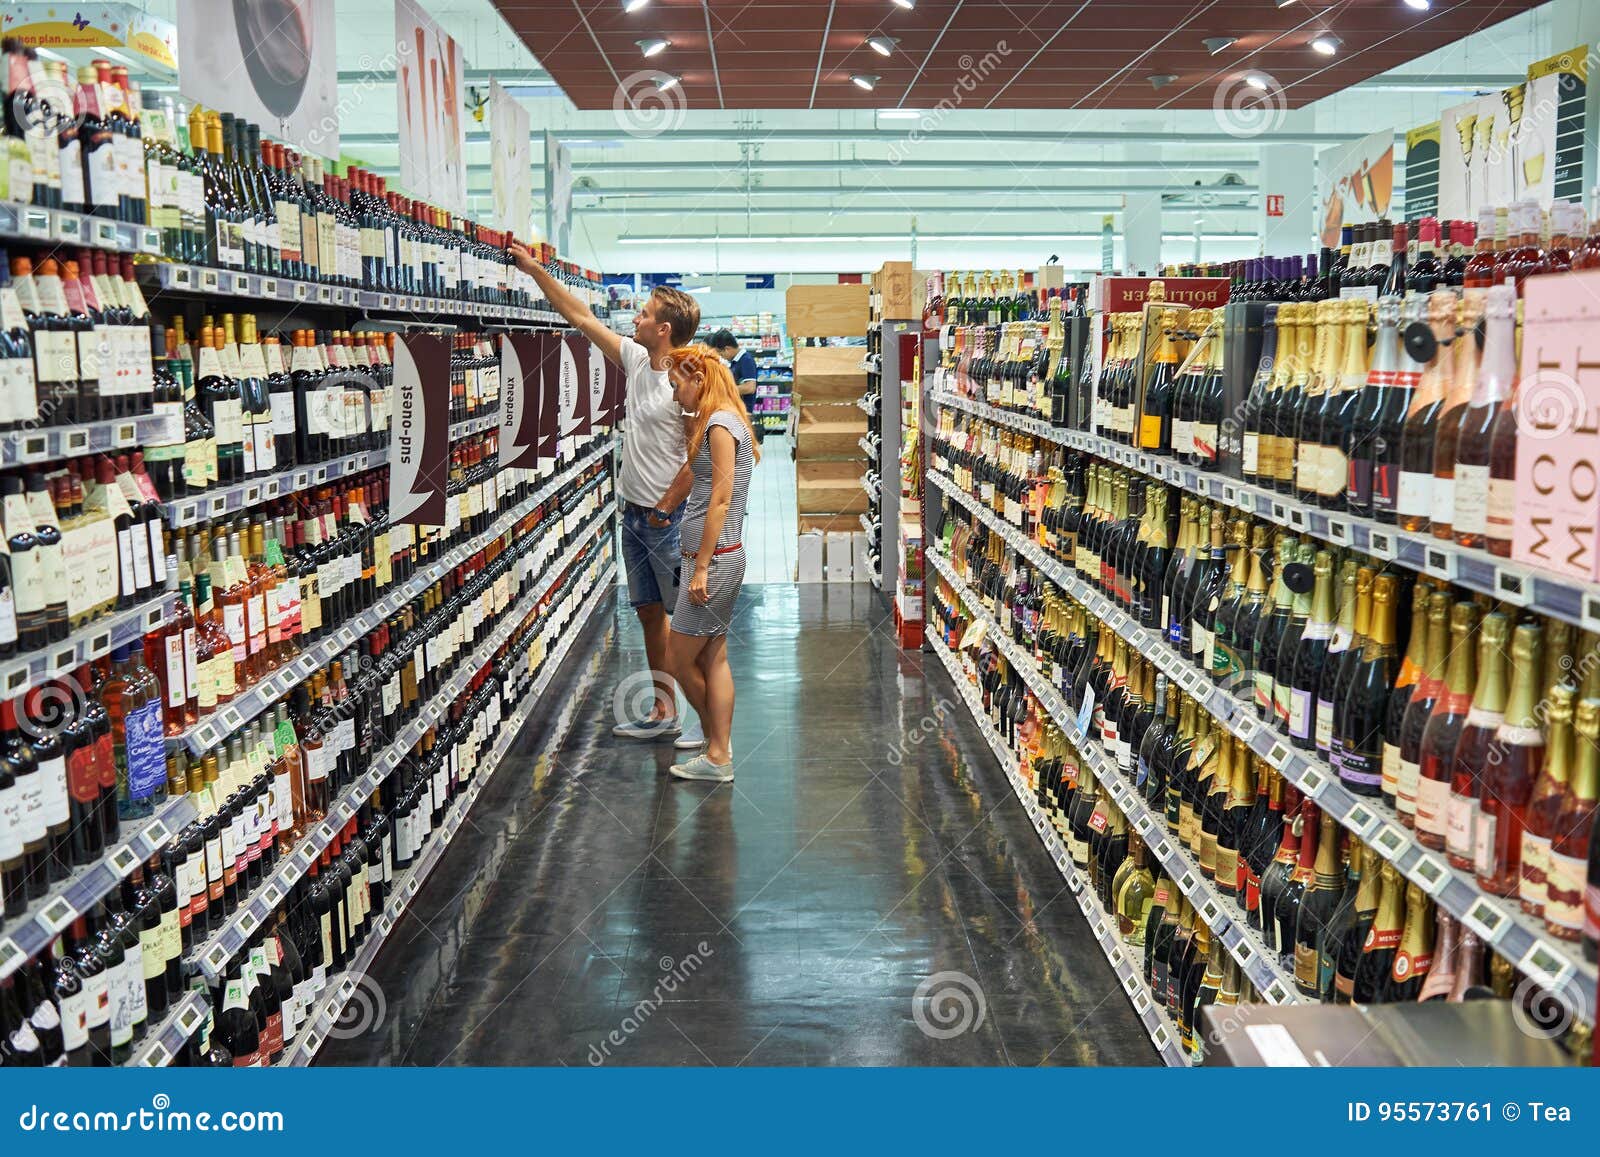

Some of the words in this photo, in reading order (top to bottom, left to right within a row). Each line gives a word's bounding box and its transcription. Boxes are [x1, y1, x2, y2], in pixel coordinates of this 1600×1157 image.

[39, 34, 61, 45] plan
[1123, 290, 1217, 301] BOLLIER
[592, 367, 601, 394] graves
[504, 377, 515, 427] bordeaux
[399, 385, 413, 464] sud-ouest
